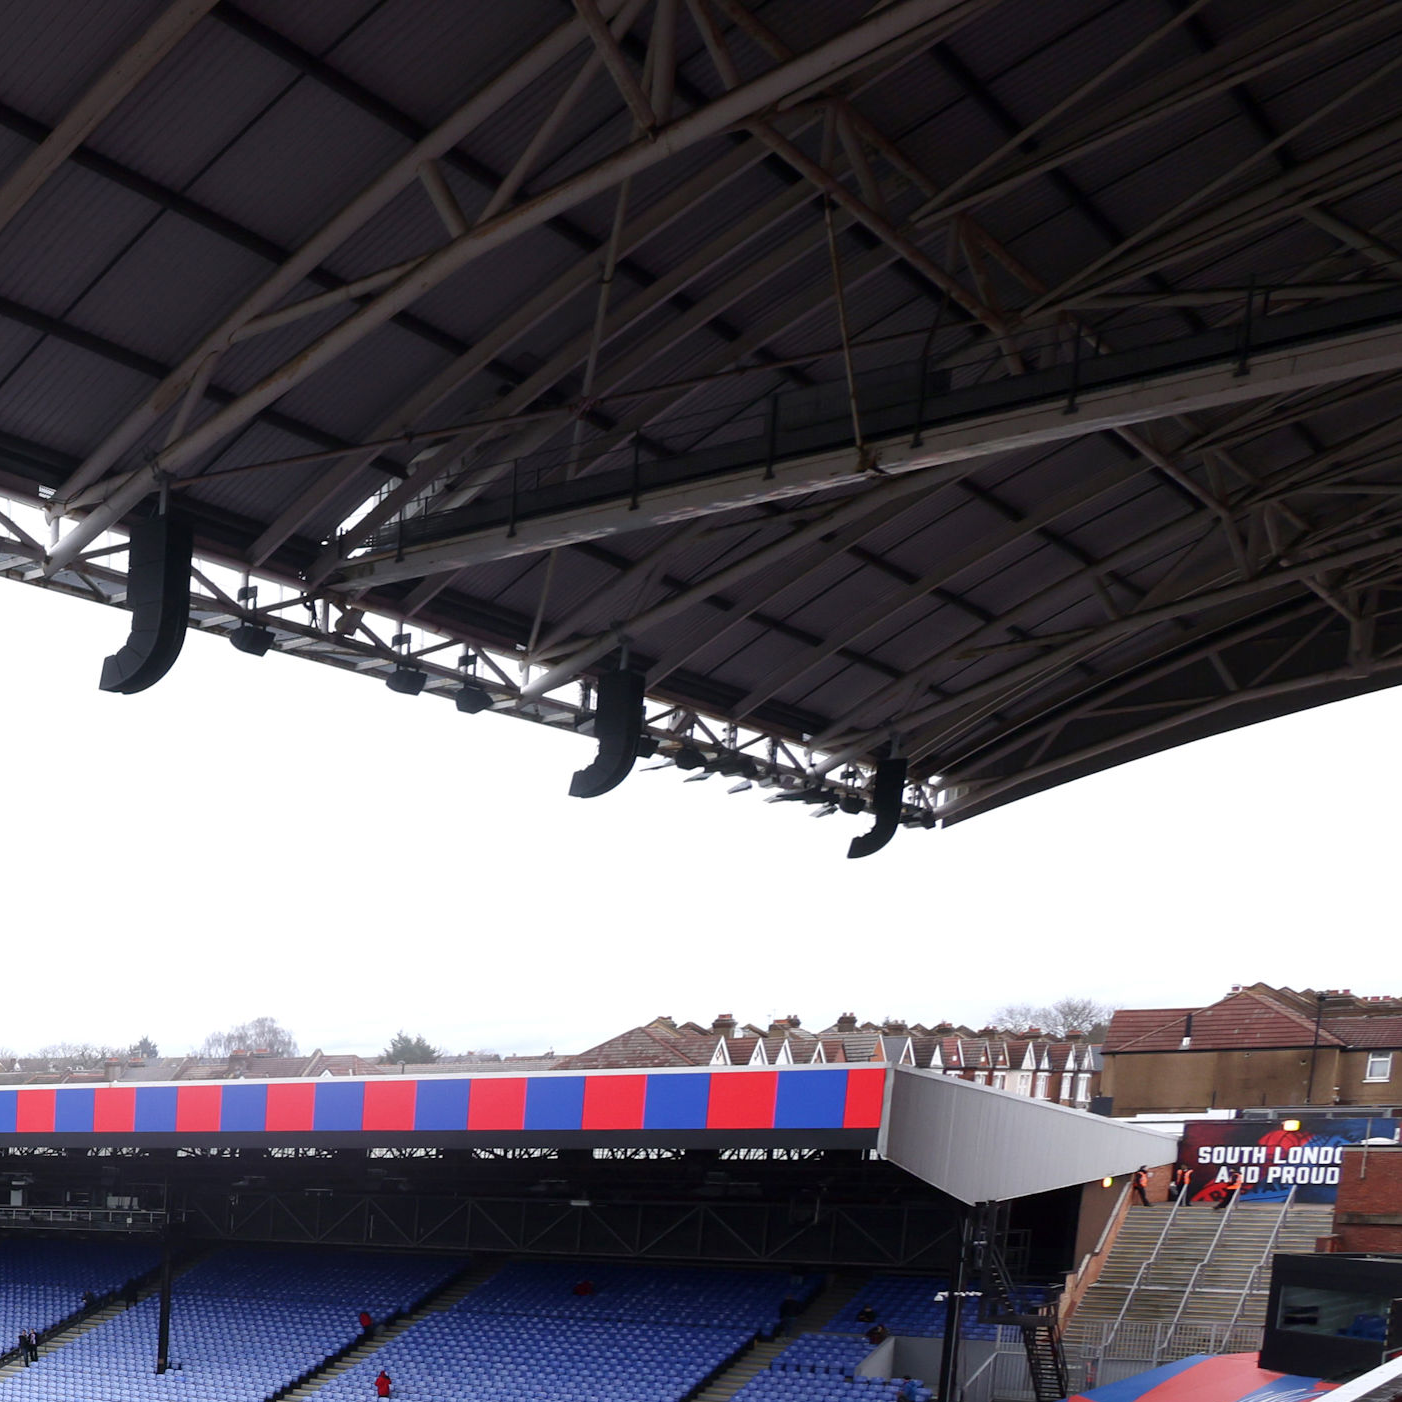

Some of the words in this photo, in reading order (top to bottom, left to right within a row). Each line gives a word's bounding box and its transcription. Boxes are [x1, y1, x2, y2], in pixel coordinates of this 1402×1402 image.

[1198, 1146, 1267, 1164] SOUTH
[1274, 1146, 1343, 1164] LOND
[1267, 1166, 1340, 1184] PROUD
